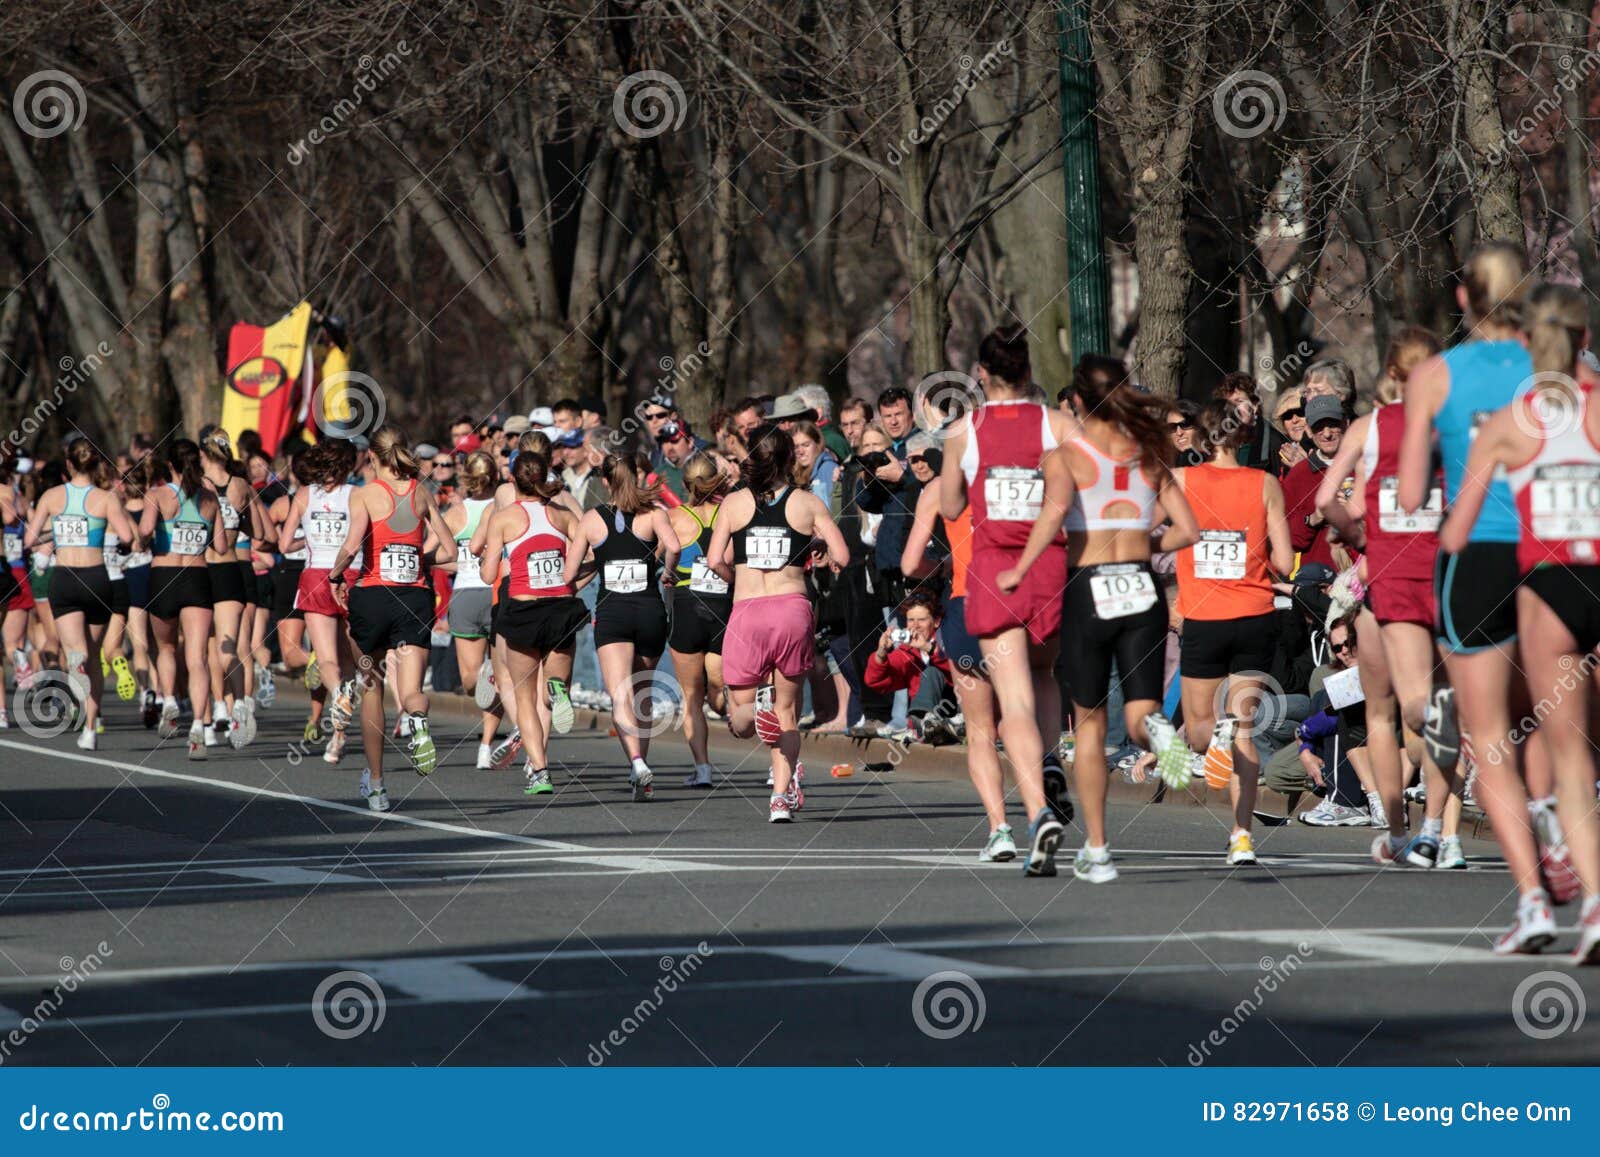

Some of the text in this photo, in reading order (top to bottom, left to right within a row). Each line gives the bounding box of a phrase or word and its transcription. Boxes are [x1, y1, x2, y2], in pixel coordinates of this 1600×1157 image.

[994, 480, 1036, 500] 157
[58, 521, 83, 534] 158
[316, 520, 342, 534] 139
[178, 529, 203, 543] 106
[752, 539, 783, 554] 111
[1202, 543, 1239, 561] 143
[386, 554, 416, 570] 155
[534, 558, 562, 574] 109
[615, 565, 635, 580] 71
[1102, 574, 1145, 596] 103
